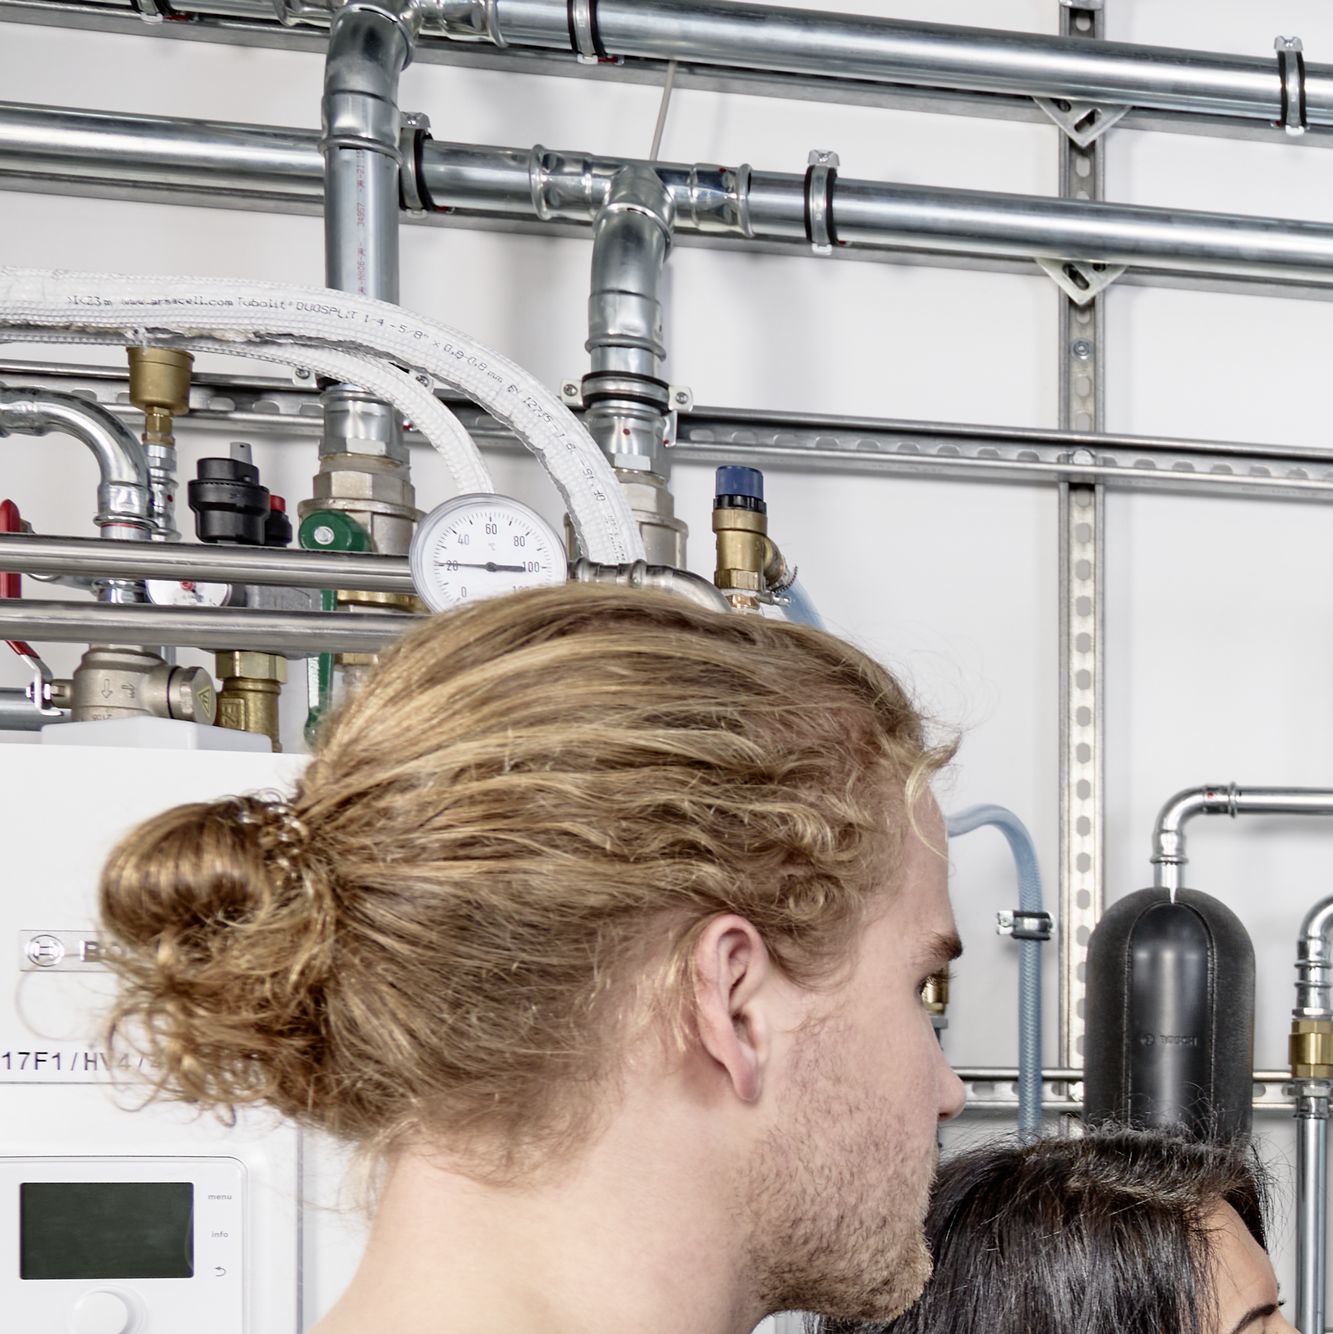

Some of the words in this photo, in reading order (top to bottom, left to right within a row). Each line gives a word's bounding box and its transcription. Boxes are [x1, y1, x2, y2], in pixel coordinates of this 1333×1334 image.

[485, 523, 498, 535] 60
[457, 534, 470, 546] 40
[513, 535, 526, 547] 80
[446, 559, 459, 572] 20
[522, 561, 540, 573] 100
[460, 586, 467, 598] 0
[207, 1193, 233, 1201] menu
[211, 1231, 229, 1239] info
